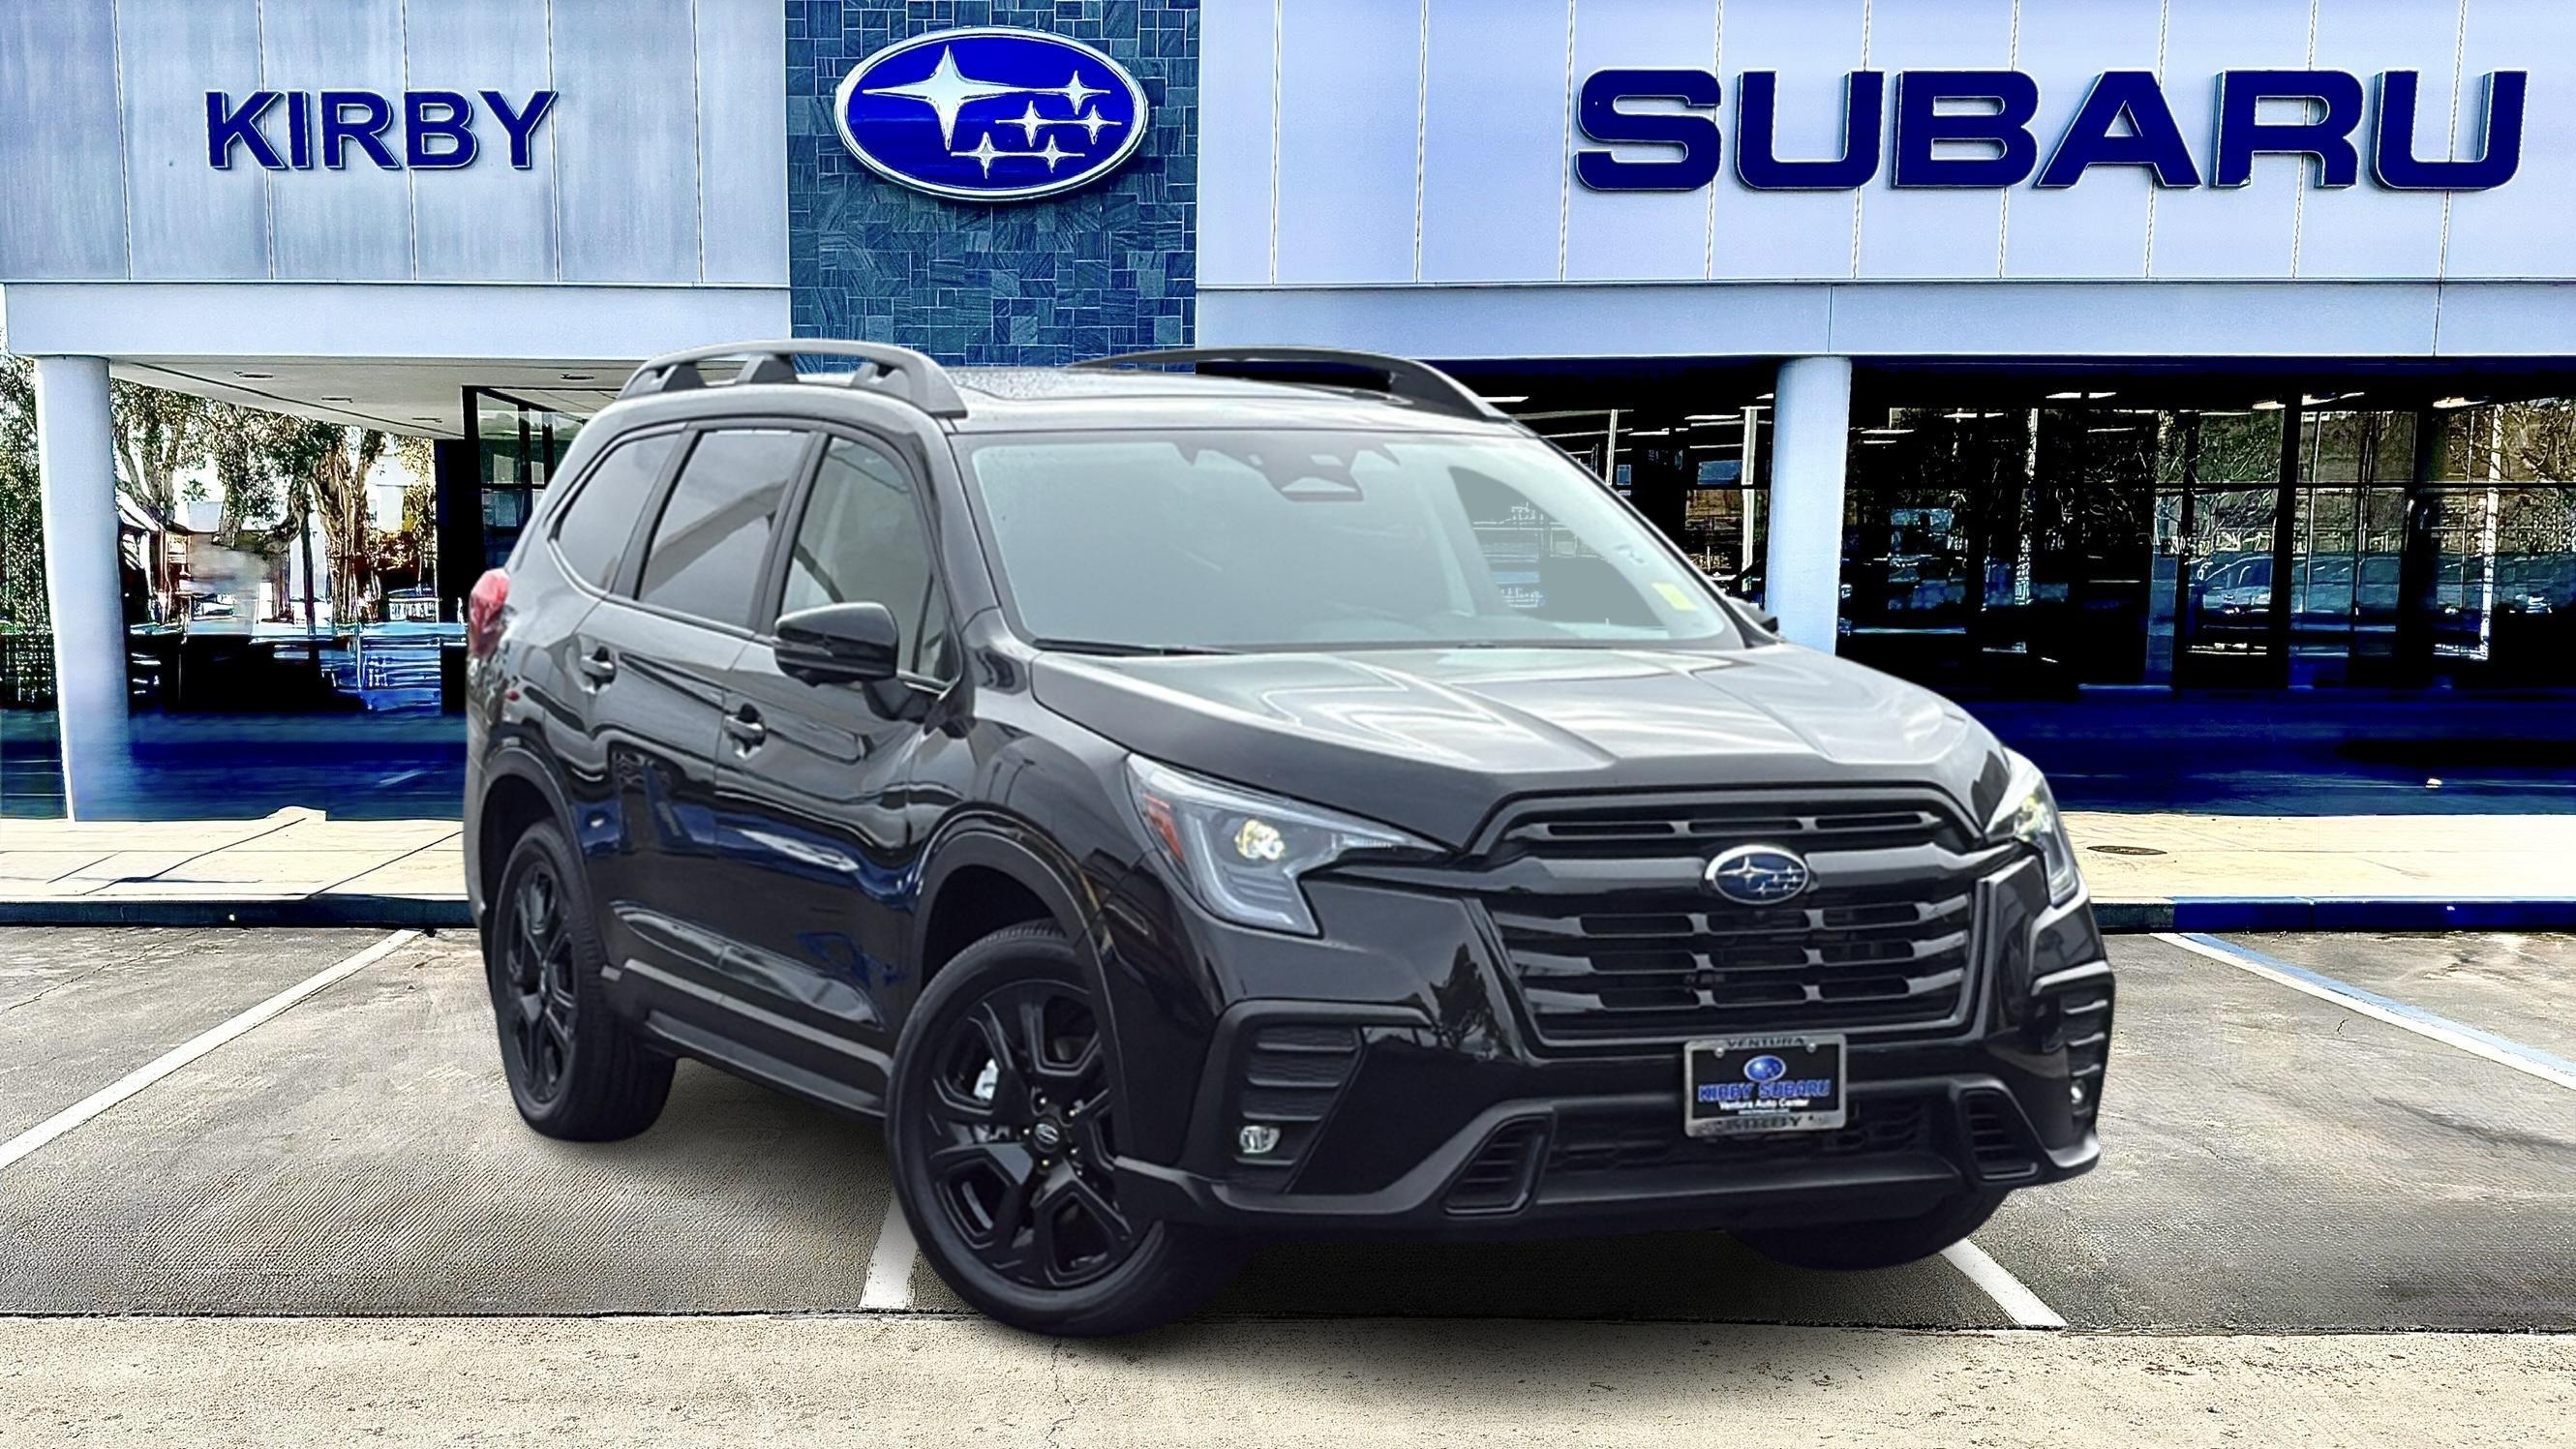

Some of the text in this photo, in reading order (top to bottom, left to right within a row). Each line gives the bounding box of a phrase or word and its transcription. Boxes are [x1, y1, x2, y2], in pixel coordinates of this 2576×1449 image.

[205, 90, 559, 169] KIRBY
[1575, 69, 2529, 191] SUBARU
[1727, 1037, 1805, 1048] VENTURA
[1698, 1079, 1831, 1102] KIRBY SUBARU
